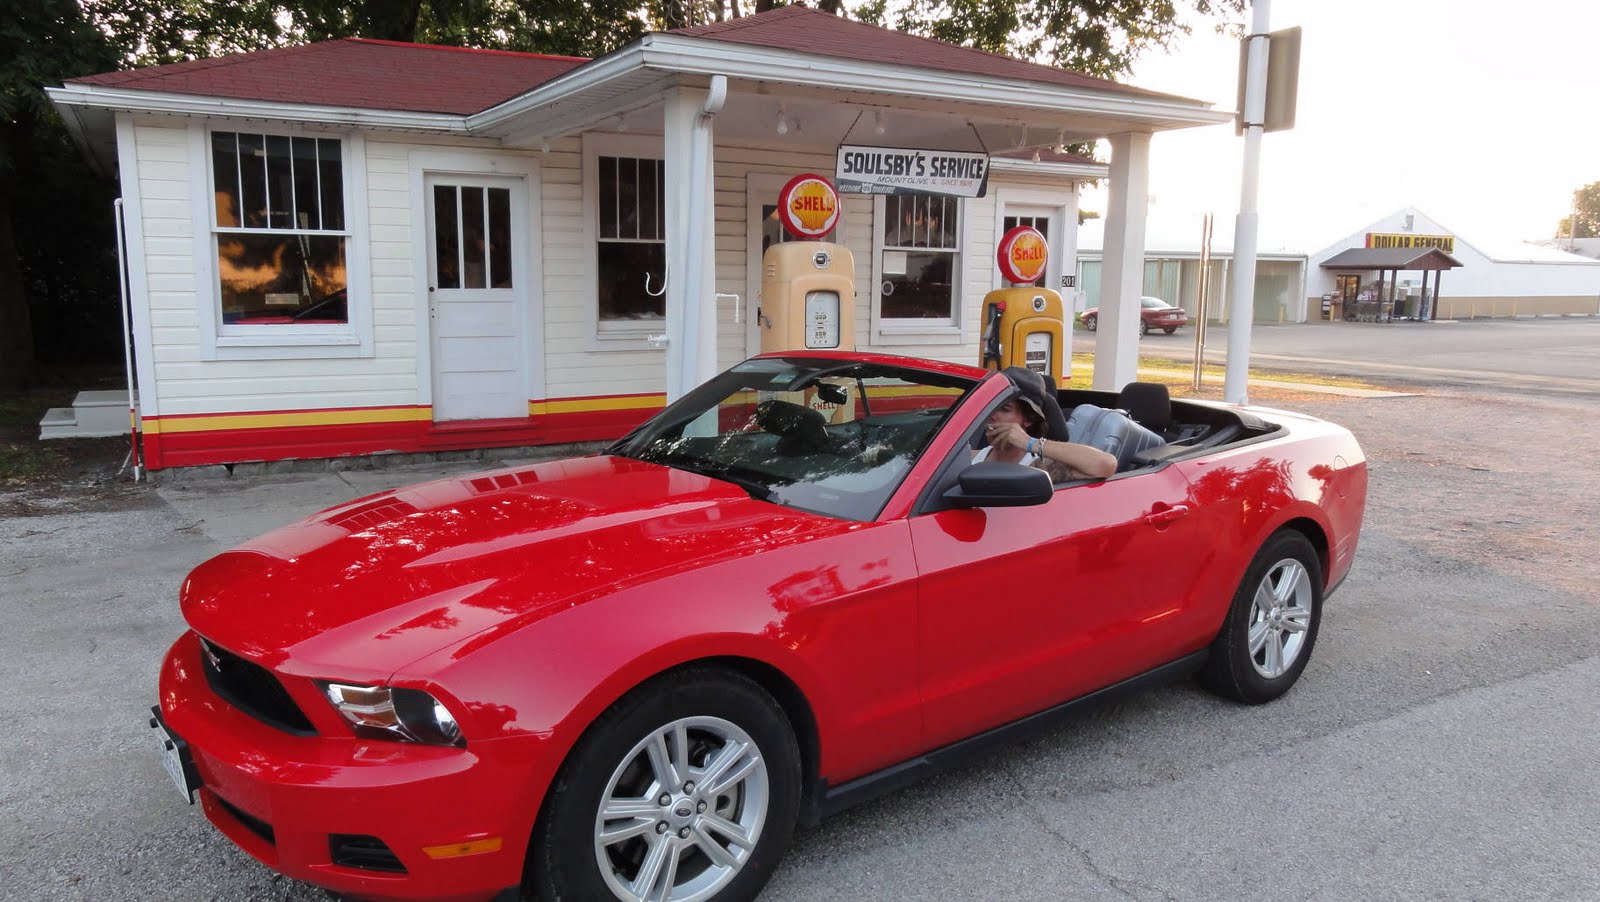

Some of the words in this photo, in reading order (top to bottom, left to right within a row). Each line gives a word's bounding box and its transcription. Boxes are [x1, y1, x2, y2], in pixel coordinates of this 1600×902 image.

[844, 152, 925, 176] SOULSBY'S
[930, 156, 984, 179] SERVICE
[877, 176, 908, 184] MOUNT
[795, 196, 832, 211] SHELL
[1375, 236, 1411, 249] DOLLAR
[1414, 237, 1453, 251] GENERAL
[1014, 247, 1043, 261] SHELL
[1062, 276, 1075, 287] 201
[813, 402, 836, 411] SHELL
